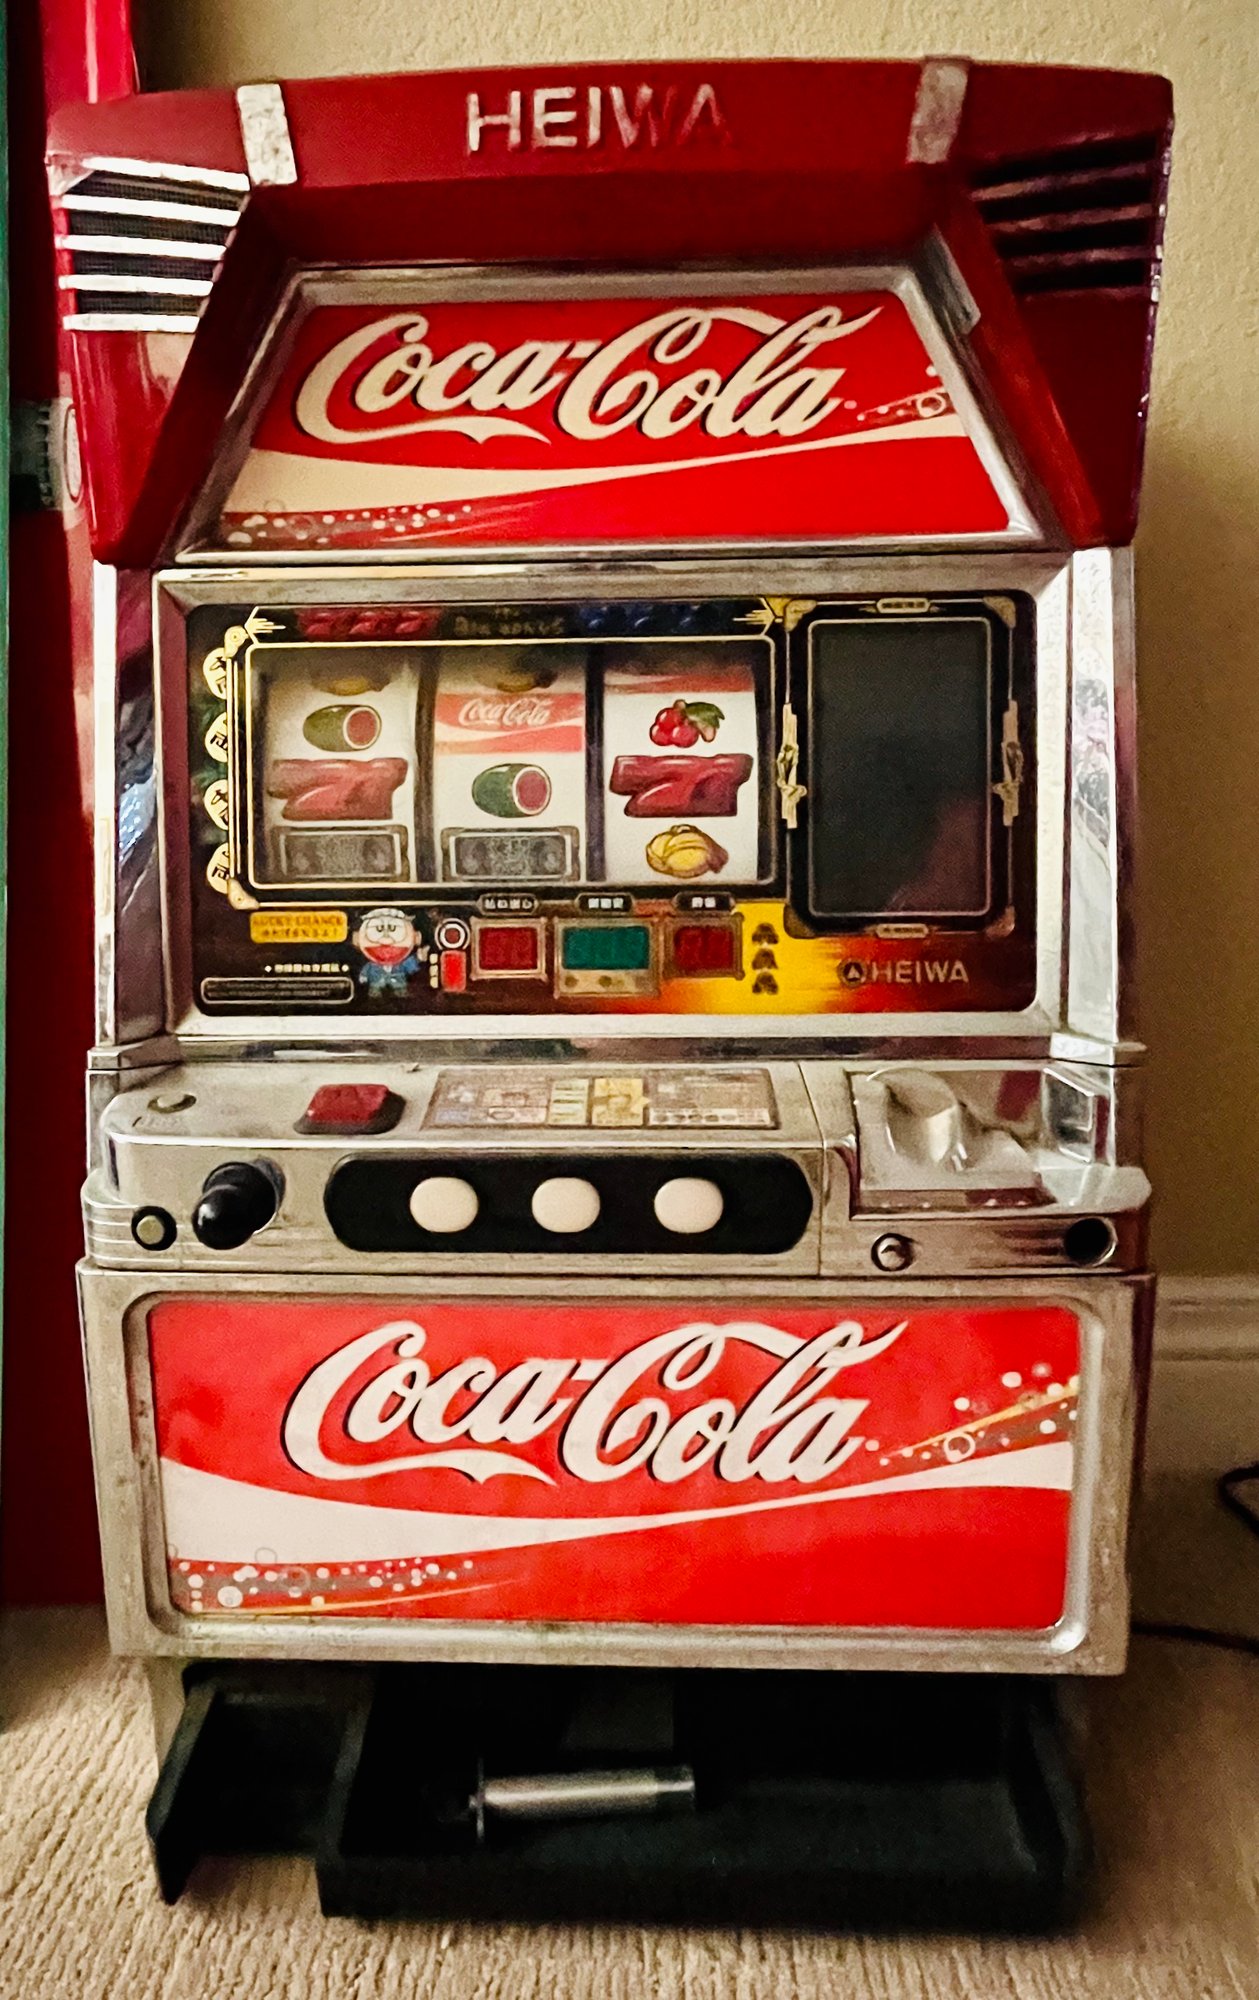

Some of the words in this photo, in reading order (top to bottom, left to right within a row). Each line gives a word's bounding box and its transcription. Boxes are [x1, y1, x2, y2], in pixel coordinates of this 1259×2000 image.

[466, 83, 733, 154] HEIWA
[295, 305, 885, 445] Coca-Cola
[871, 959, 969, 983] HEIWA
[282, 1319, 909, 1486] Coca-Cola
